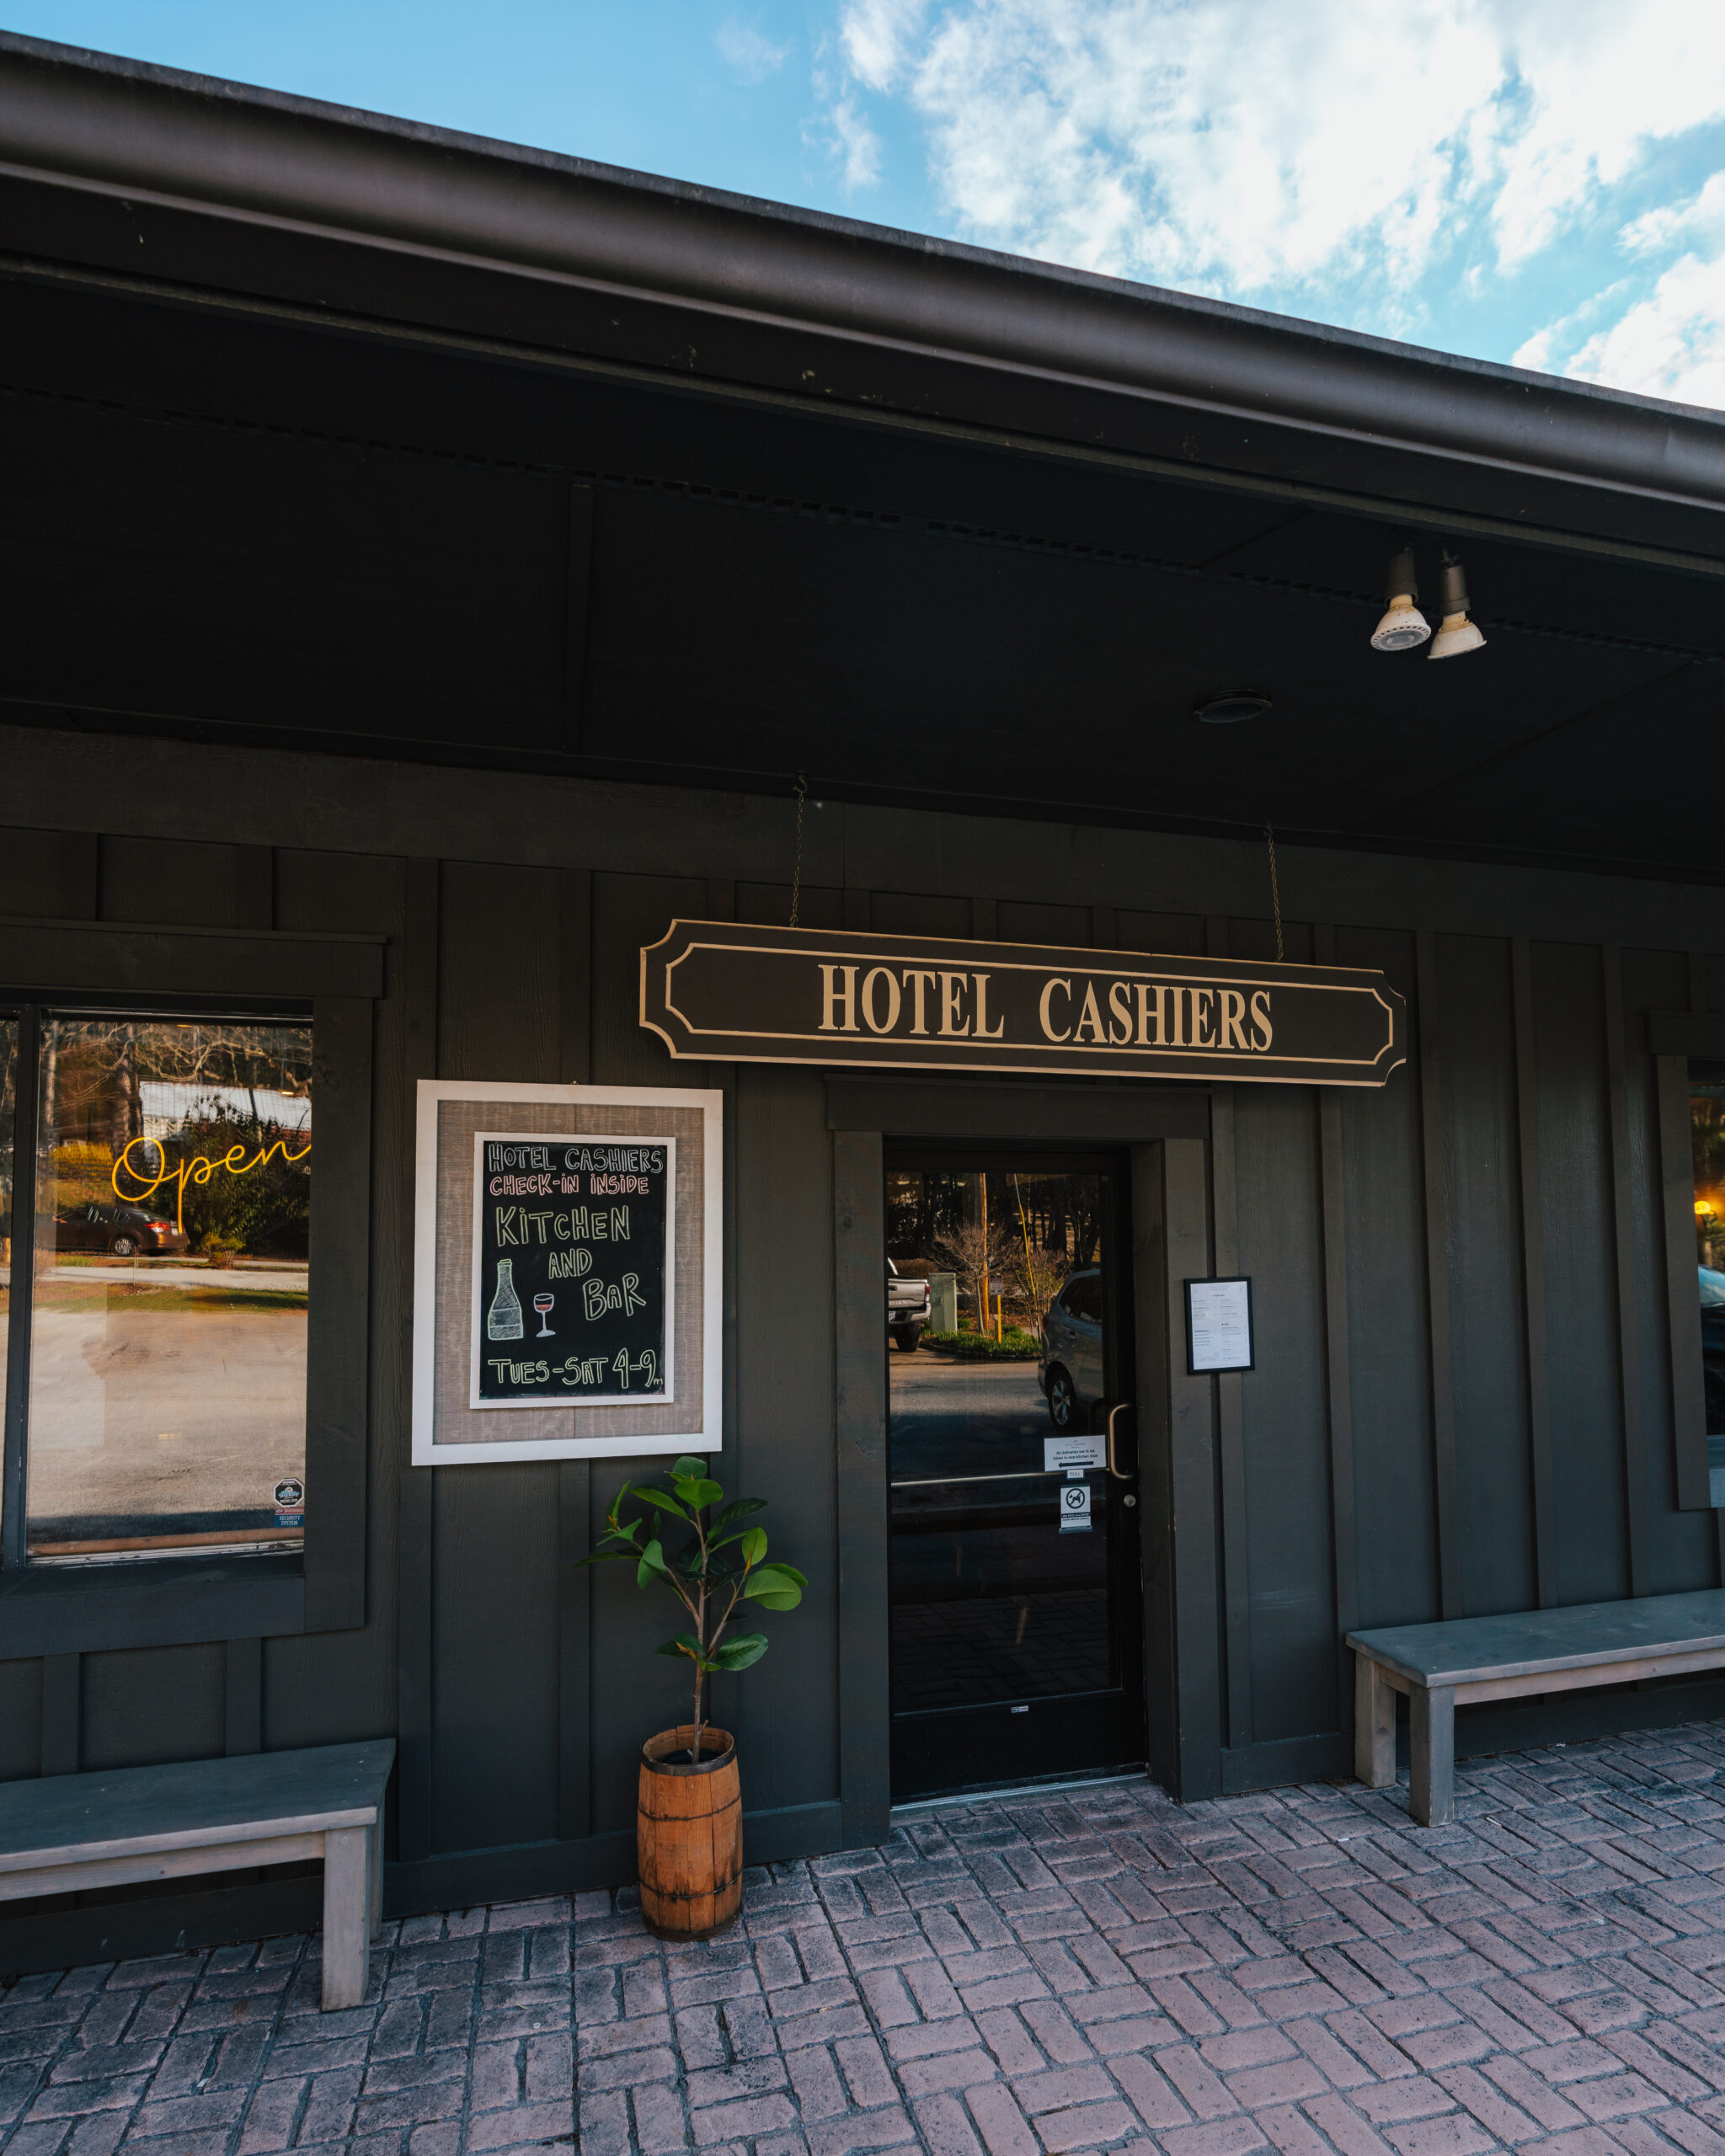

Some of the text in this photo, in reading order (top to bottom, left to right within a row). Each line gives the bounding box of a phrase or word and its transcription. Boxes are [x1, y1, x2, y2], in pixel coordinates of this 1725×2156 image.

[818, 964, 1273, 1051] HOTEL CASHIERS
[489, 1144, 664, 1173] HOTEL CASHIERS
[111, 1136, 312, 1234] Open
[548, 1248, 593, 1279] AND
[582, 1273, 647, 1321] BAR
